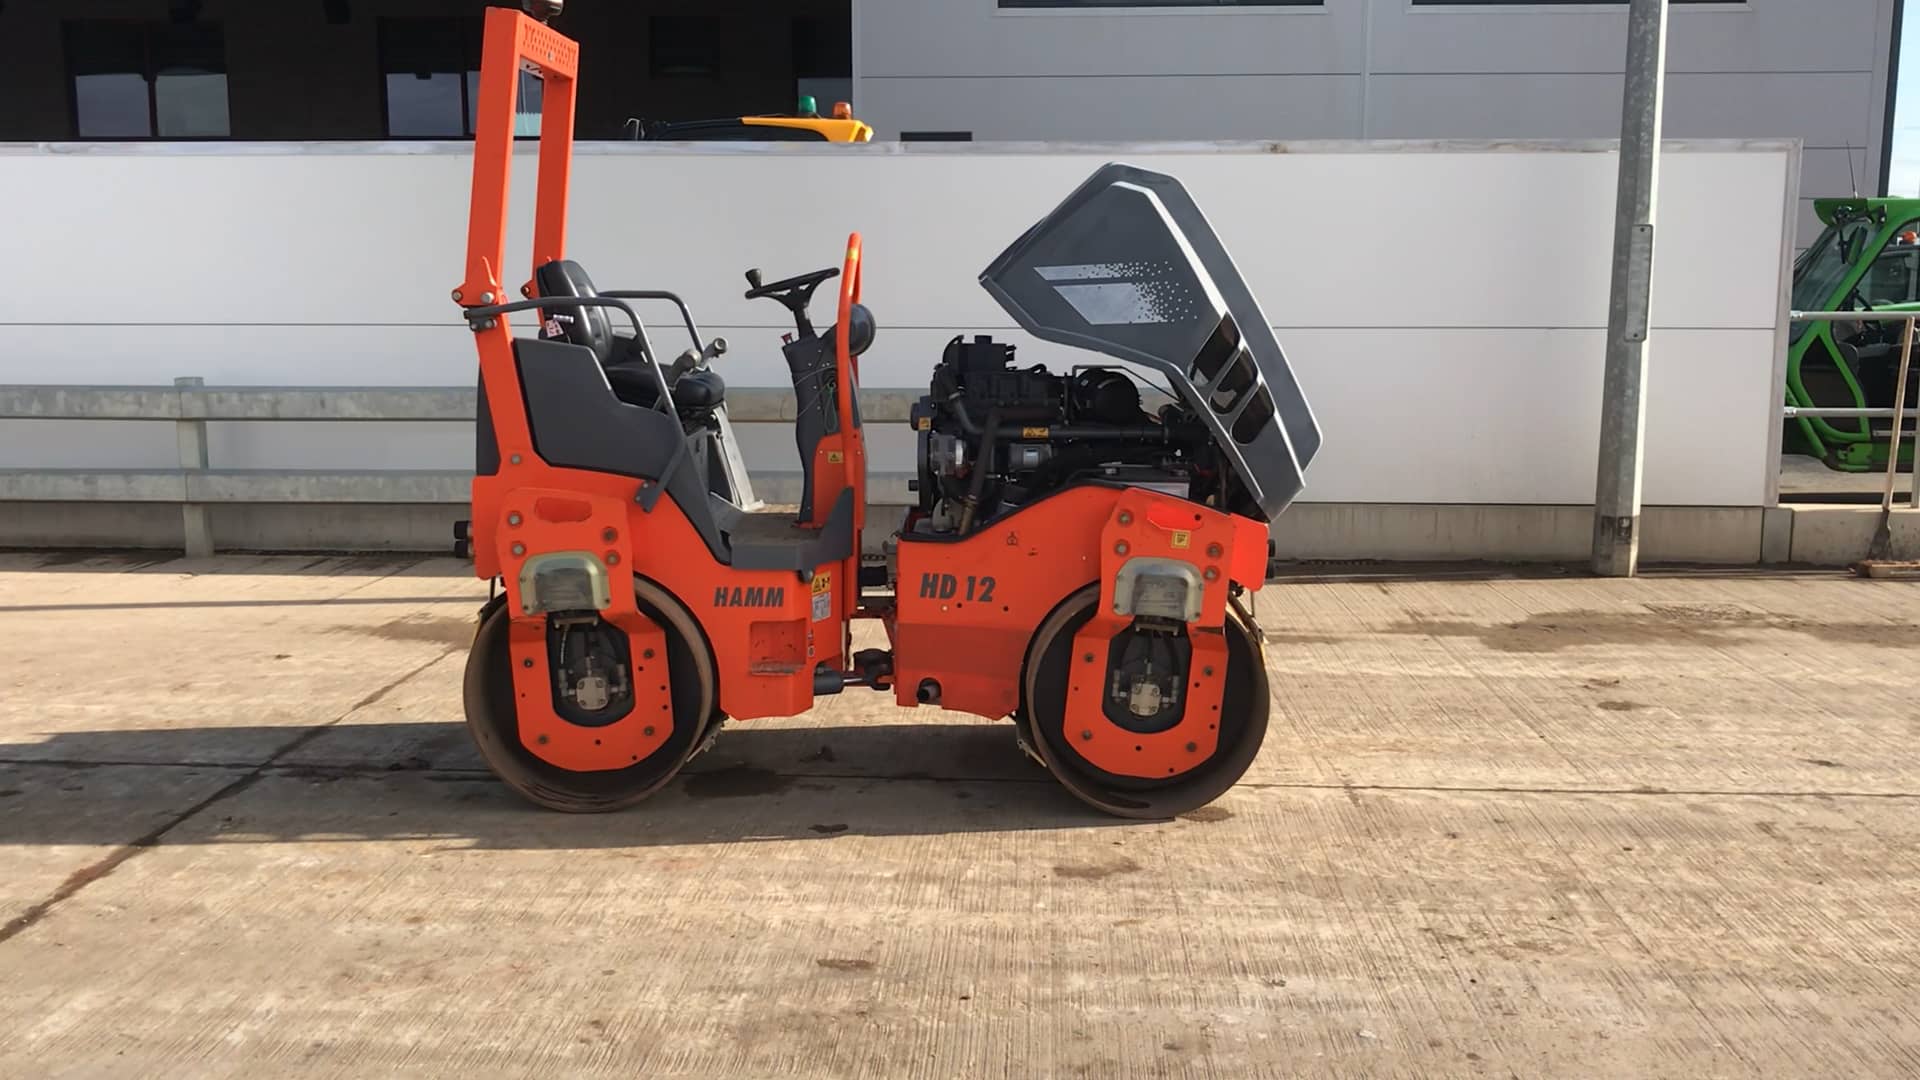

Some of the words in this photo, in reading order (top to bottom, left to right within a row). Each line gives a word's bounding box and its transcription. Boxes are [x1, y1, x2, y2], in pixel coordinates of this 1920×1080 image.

[713, 586, 785, 608] HAMM
[919, 572, 957, 600] HD
[966, 575, 996, 602] 12
